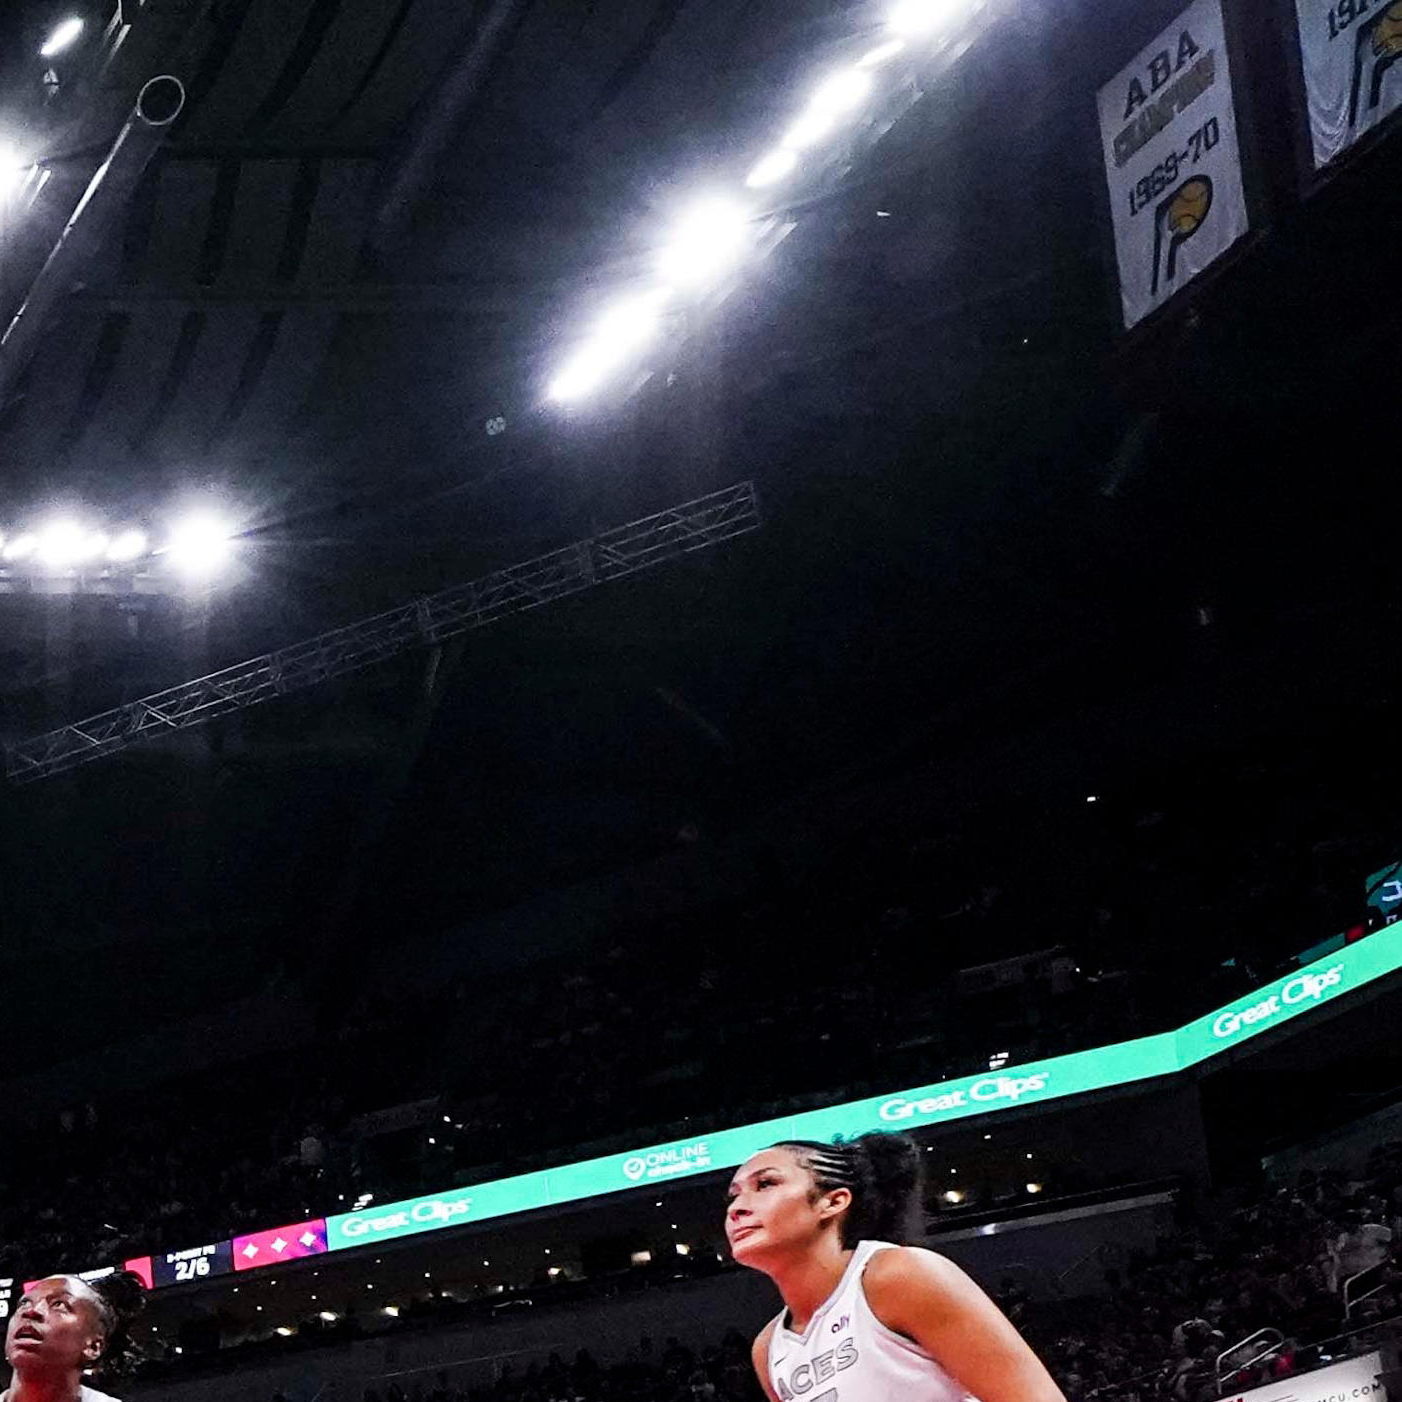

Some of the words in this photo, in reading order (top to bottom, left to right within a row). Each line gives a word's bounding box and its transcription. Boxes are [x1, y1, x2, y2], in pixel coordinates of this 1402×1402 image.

[1123, 30, 1199, 120] ABA
[1212, 996, 1280, 1039] Great
[1280, 965, 1344, 1006] Clips
[878, 1090, 966, 1122] Great
[968, 1073, 1046, 1107] Clips
[646, 1141, 710, 1166] ONLINE
[341, 1209, 409, 1238] Great
[410, 1198, 471, 1225] Clips
[174, 1256, 211, 1281] 2/6
[777, 1337, 859, 1402] ACES
